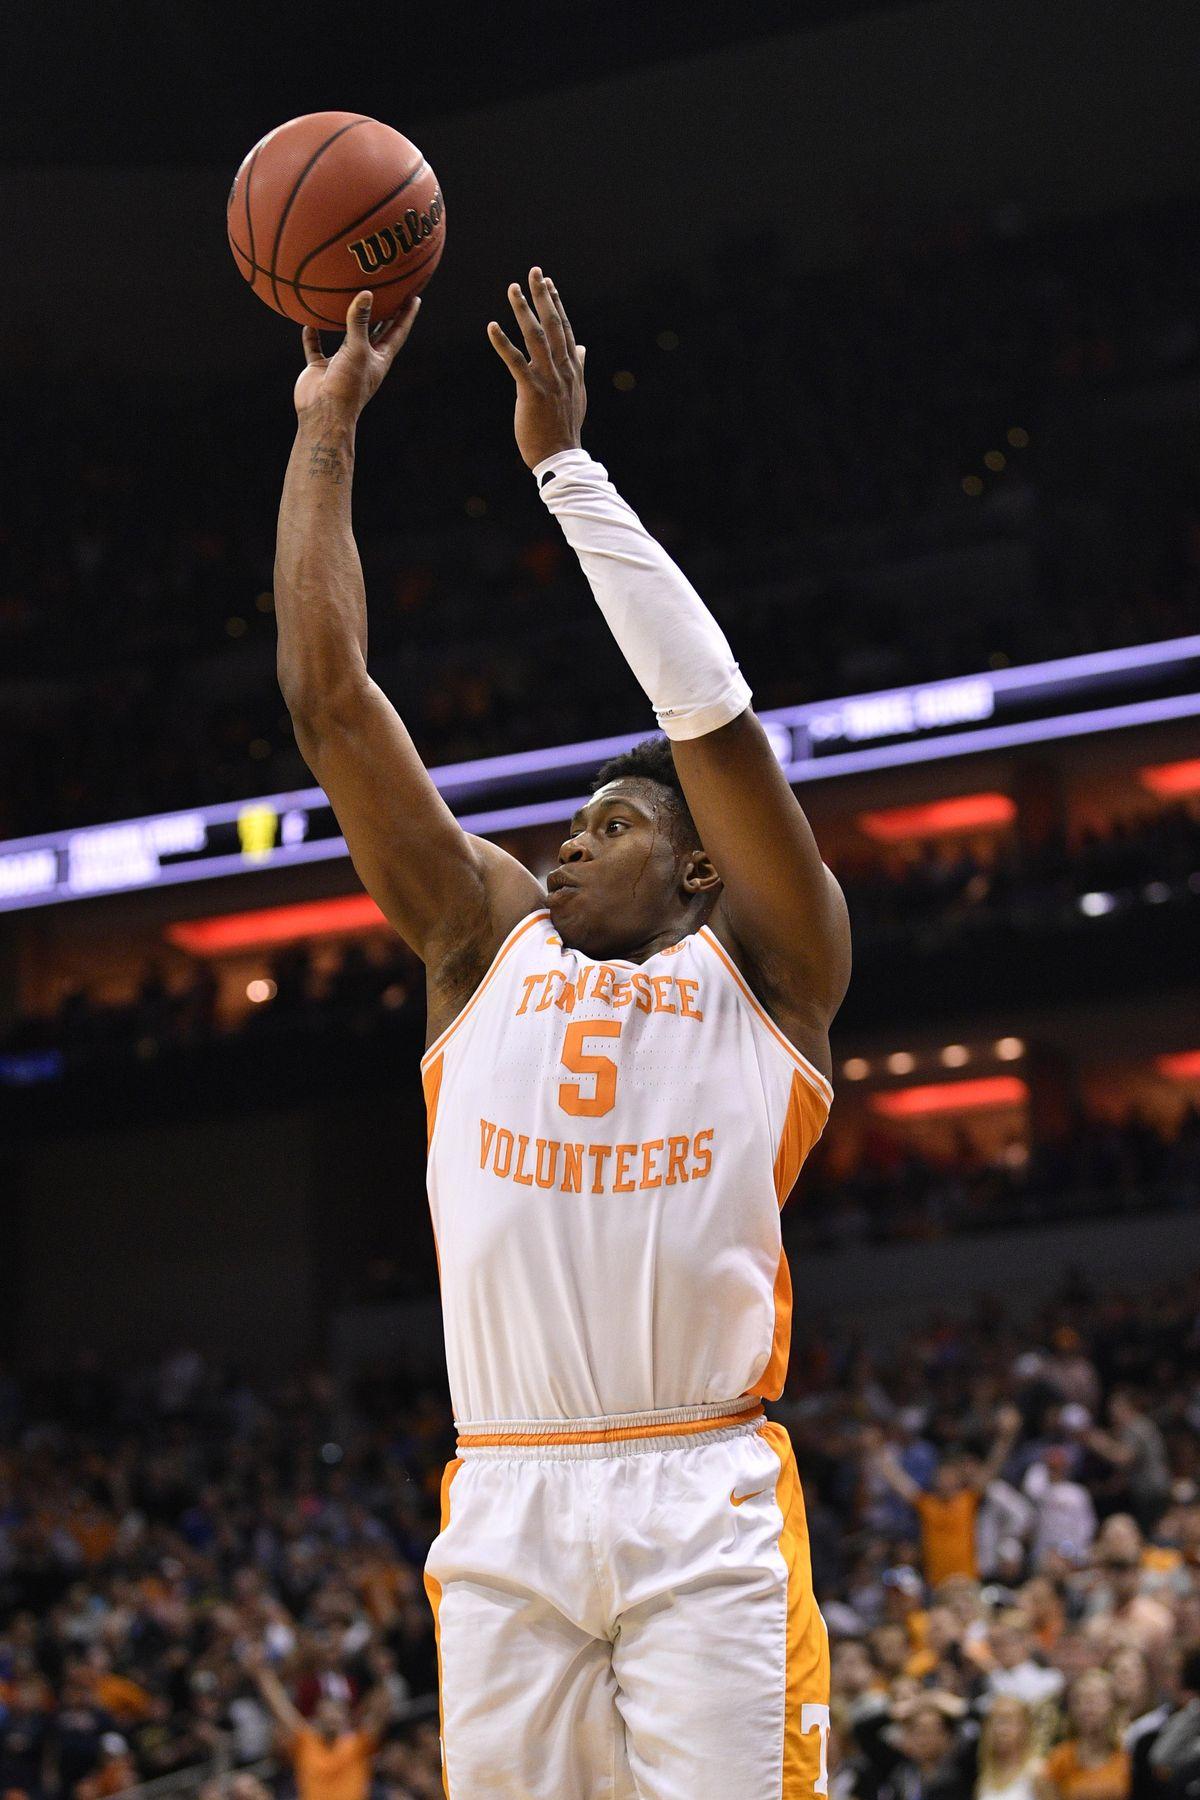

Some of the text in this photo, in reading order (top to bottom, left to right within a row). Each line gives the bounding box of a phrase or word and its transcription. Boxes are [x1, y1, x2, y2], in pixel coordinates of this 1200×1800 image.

[346, 184, 442, 274] Wilso
[558, 1019, 622, 1118] 5
[480, 1118, 715, 1195] VOLUNTEERS
[800, 1703, 831, 1795] T
